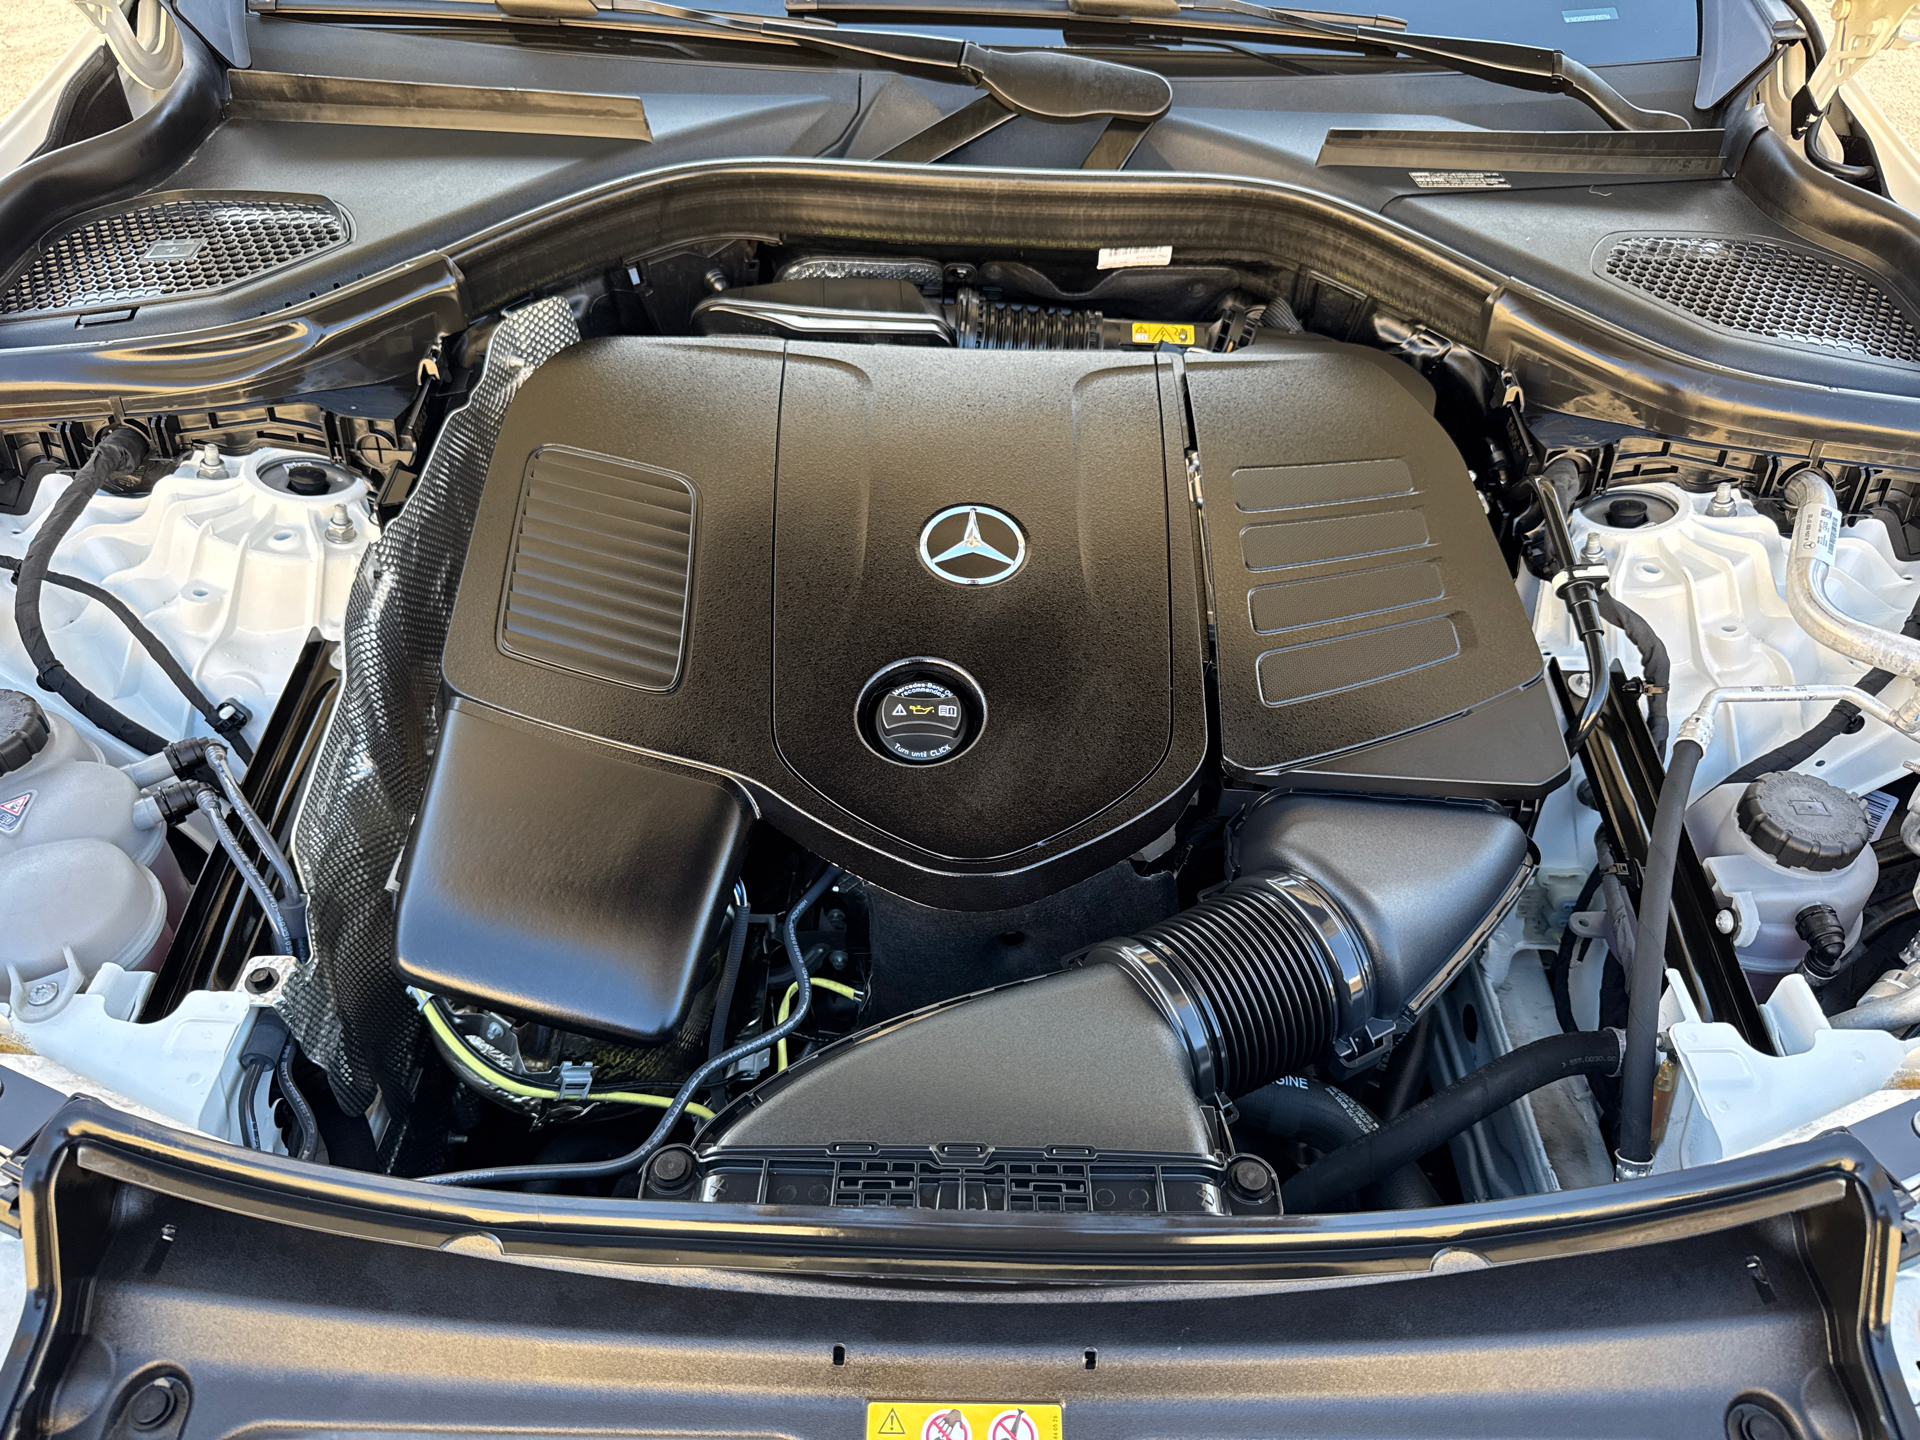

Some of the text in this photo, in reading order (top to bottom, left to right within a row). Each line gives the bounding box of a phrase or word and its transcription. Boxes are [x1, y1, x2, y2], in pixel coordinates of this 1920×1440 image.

[892, 682, 944, 696] Mercedes-Benz
[901, 688, 945, 698] recommended
[894, 742, 909, 755] Turn
[930, 744, 951, 757] CLICK
[1768, 782, 1780, 793] NOT
[1777, 777, 1800, 785] OPEN
[1803, 778, 1831, 794] WHEN
[1832, 793, 1849, 806] HOT
